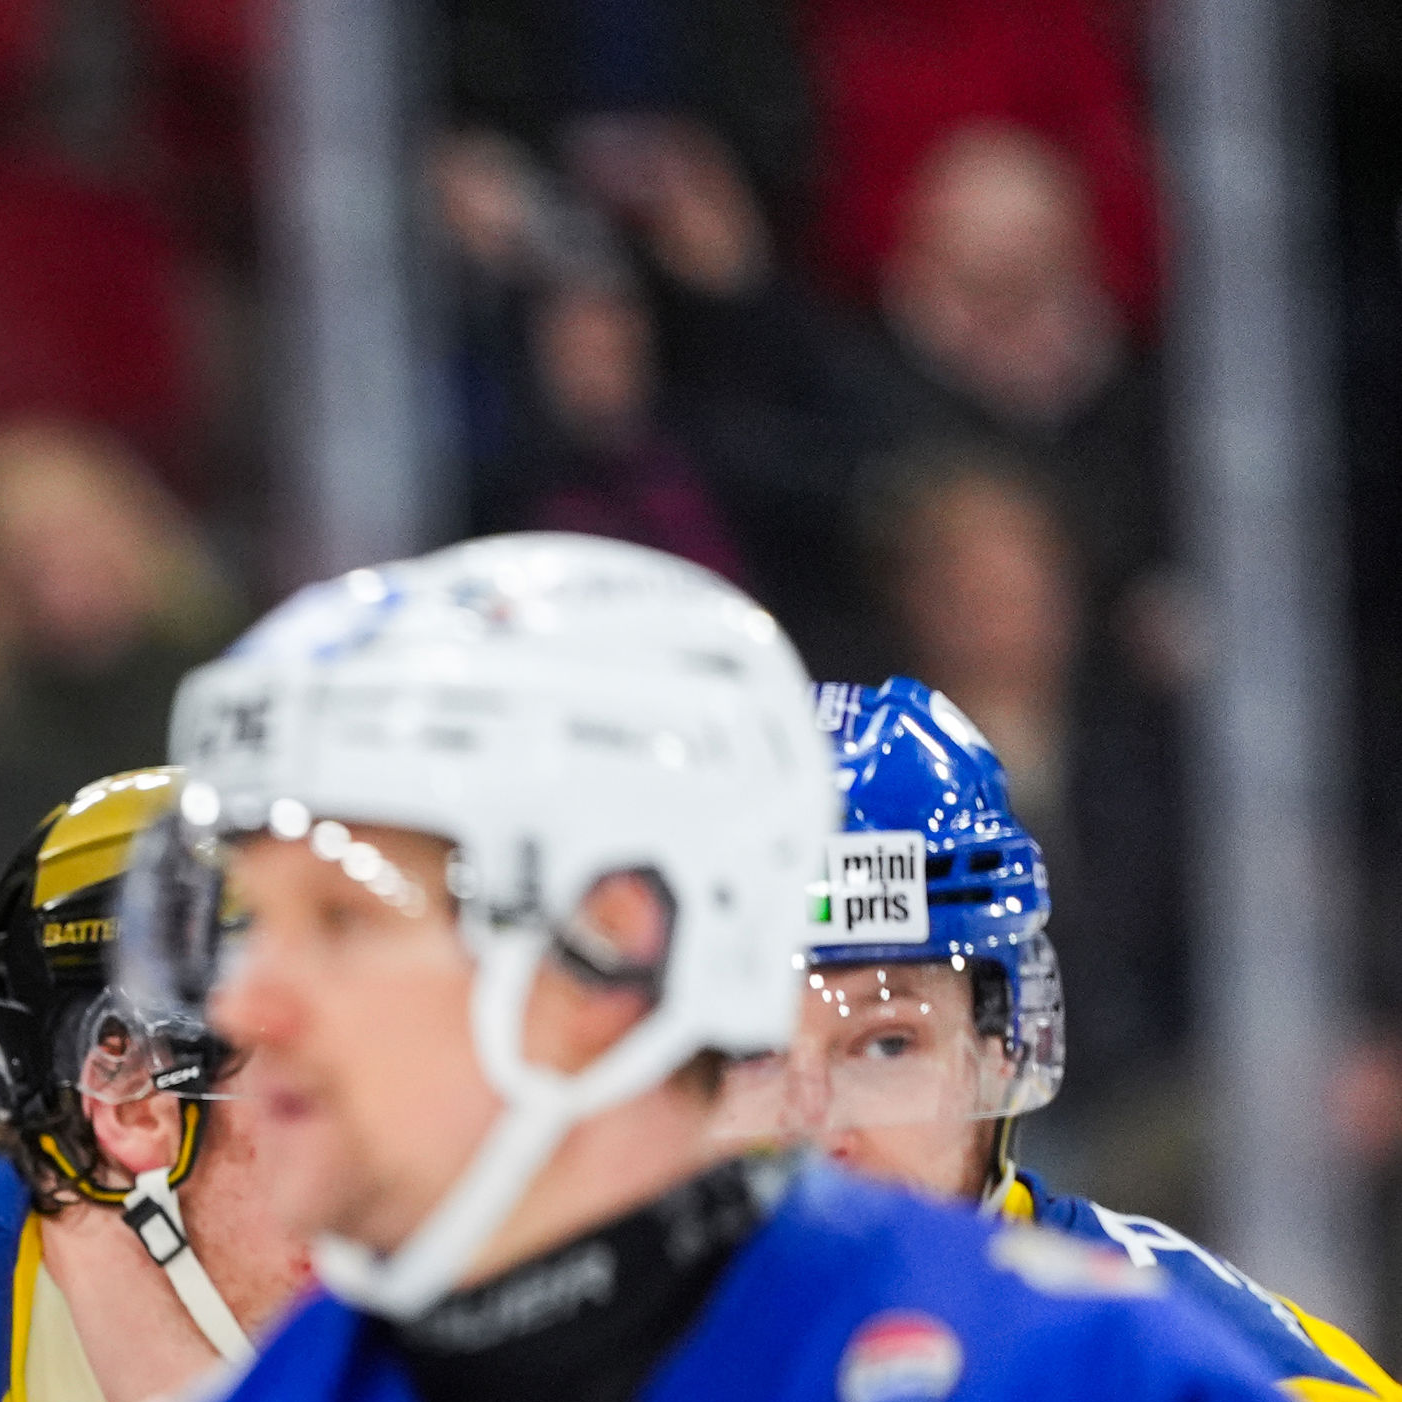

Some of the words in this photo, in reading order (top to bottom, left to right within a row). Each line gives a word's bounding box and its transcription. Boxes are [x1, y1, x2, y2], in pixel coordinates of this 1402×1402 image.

[843, 844, 916, 880] mini
[846, 889, 909, 930] pris
[42, 916, 120, 949] BATTE
